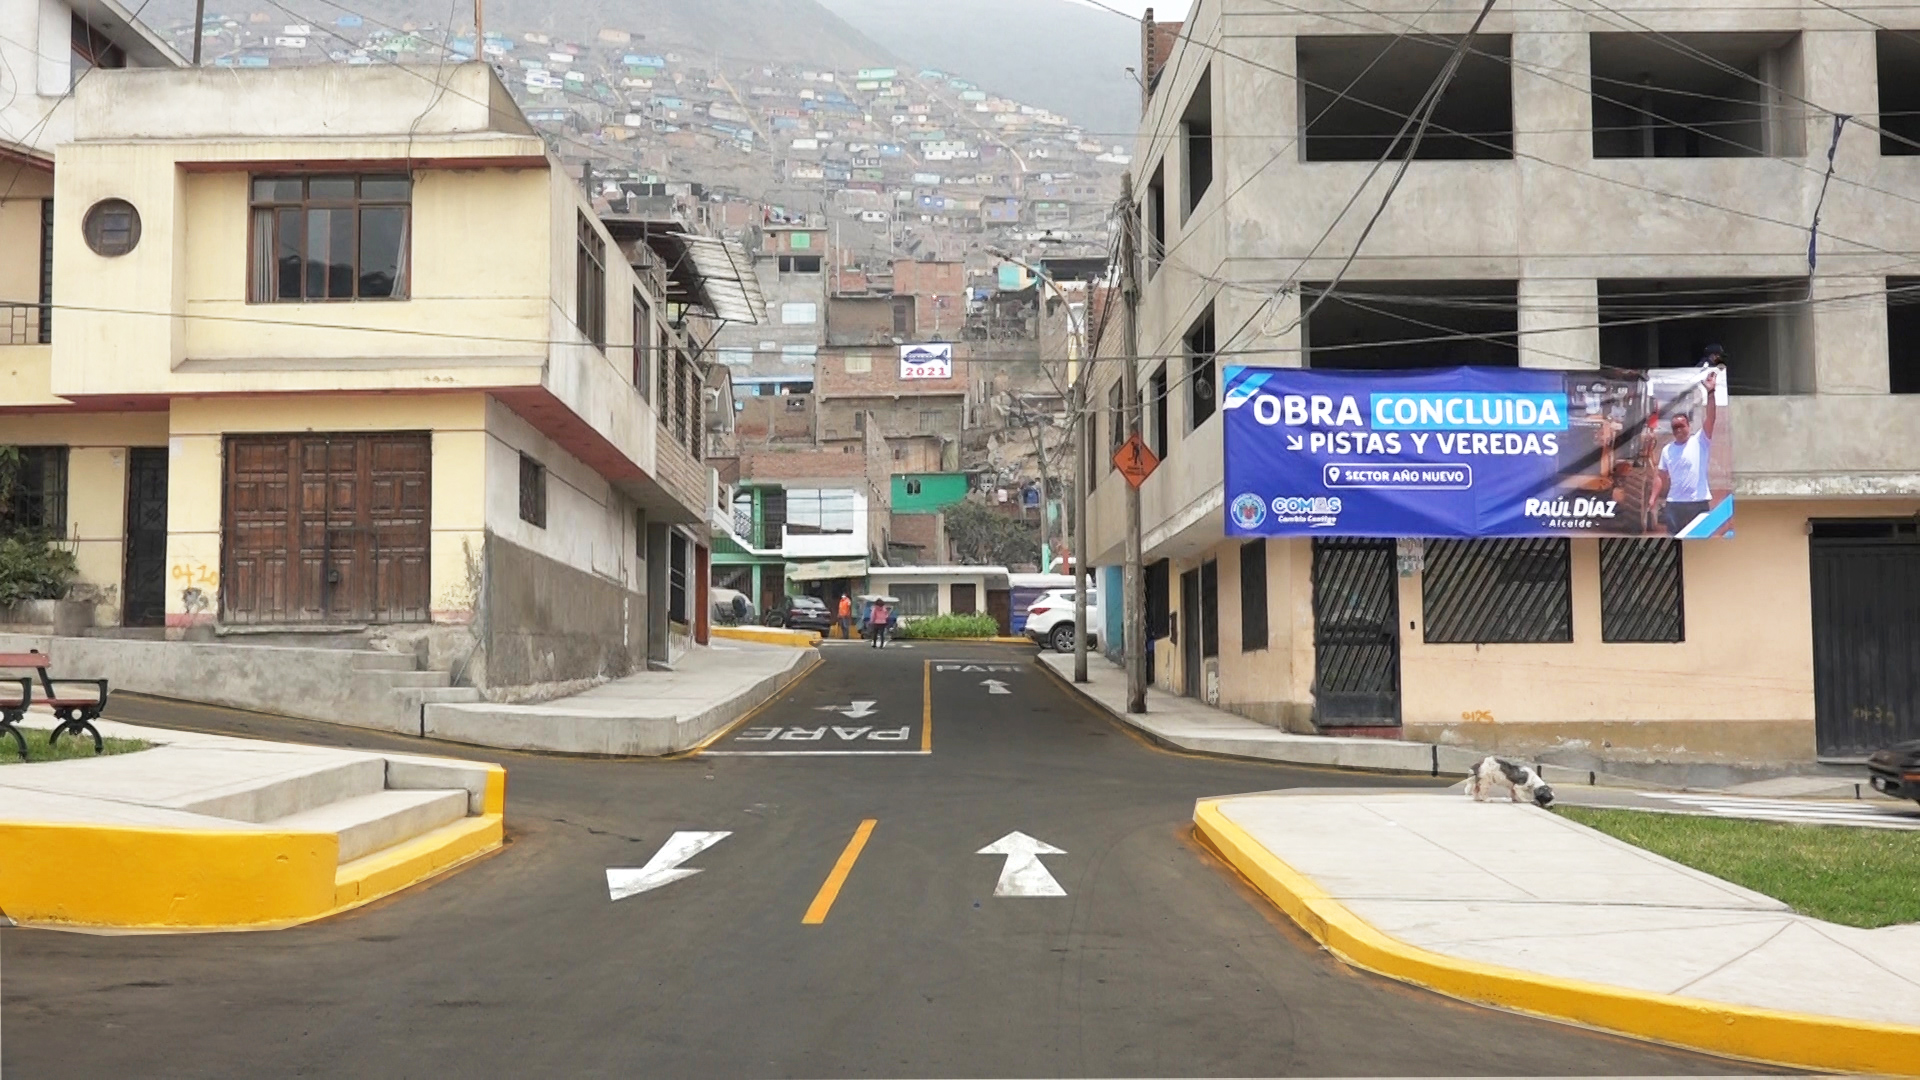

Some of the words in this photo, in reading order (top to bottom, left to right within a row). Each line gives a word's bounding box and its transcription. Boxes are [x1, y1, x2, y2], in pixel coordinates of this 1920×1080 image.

[905, 366, 946, 376] 2021
[1253, 394, 1364, 426] OBRA
[1375, 398, 1561, 425] CONCLUIDA
[1310, 431, 1402, 454] PISTAS
[1410, 432, 1429, 454] Y
[1436, 432, 1559, 456] VEREDAS
[1345, 470, 1390, 482] SECTOR
[1392, 469, 1419, 482] AÑO
[1422, 471, 1464, 482] NUEVO
[1272, 497, 1341, 514] COMAS
[1525, 496, 1571, 517] RAÚL
[1573, 496, 1617, 517] DÍAZ
[1549, 519, 1592, 528] Alcalde
[734, 725, 911, 742] PARE
